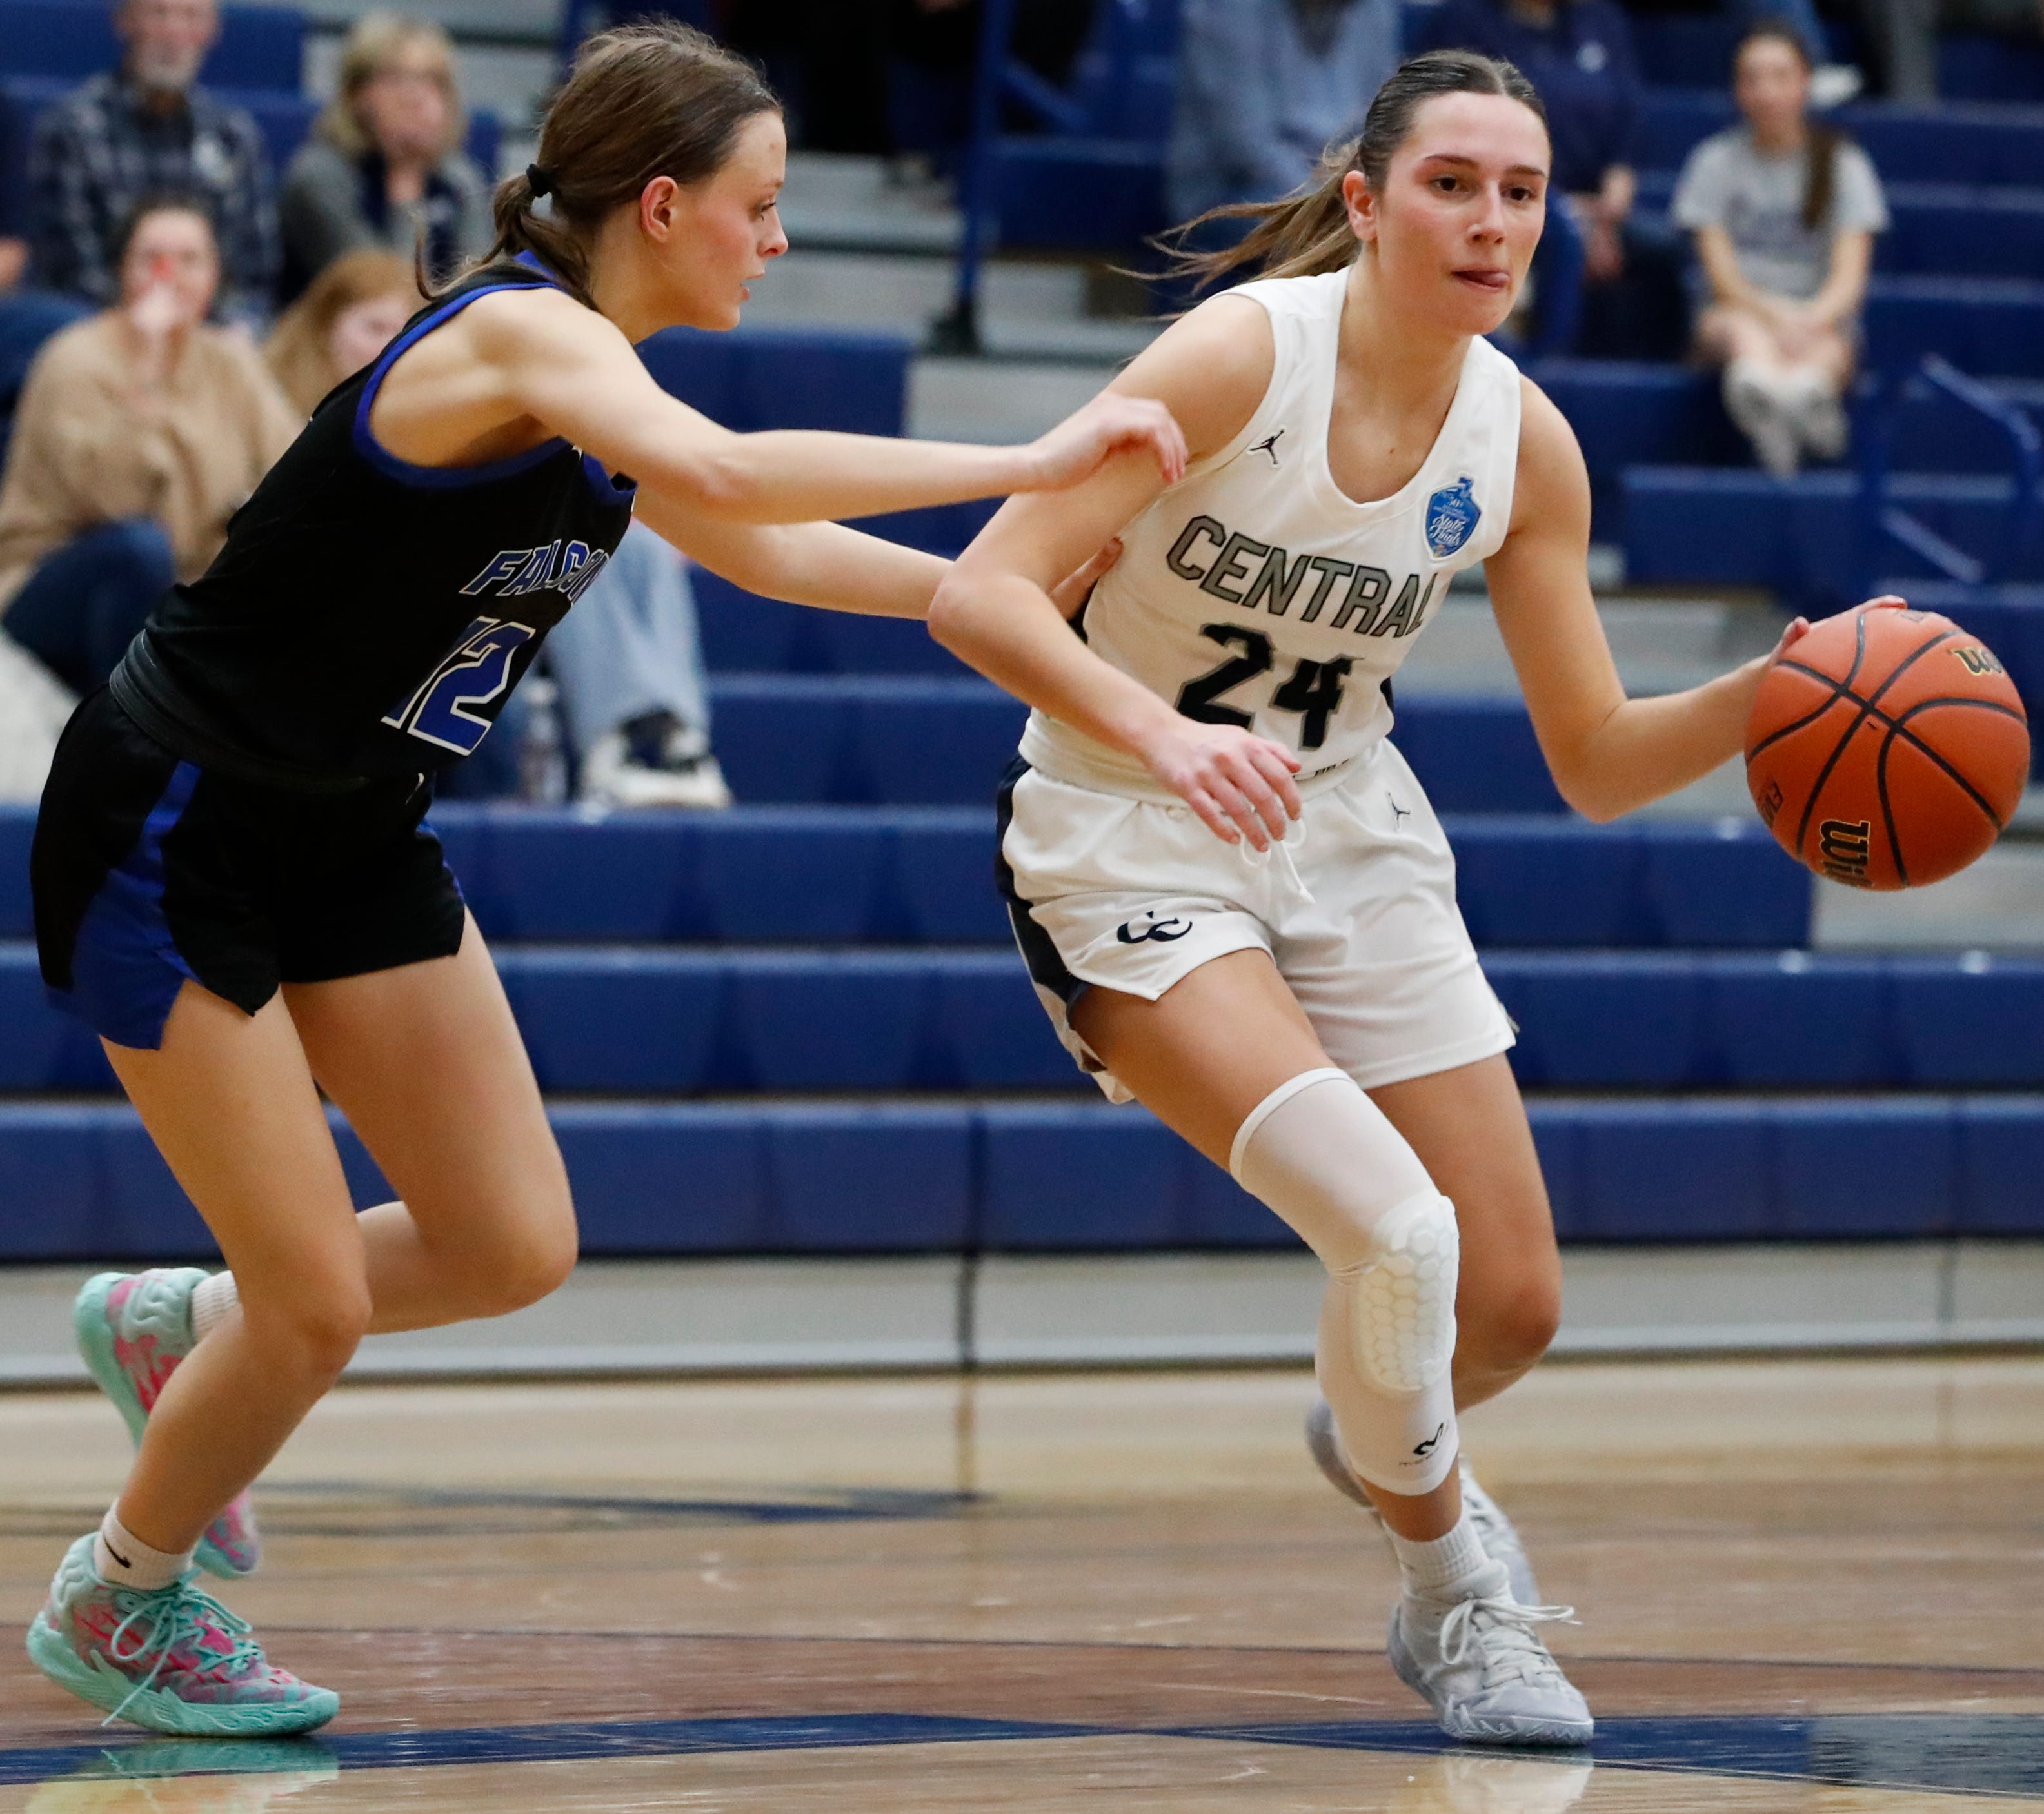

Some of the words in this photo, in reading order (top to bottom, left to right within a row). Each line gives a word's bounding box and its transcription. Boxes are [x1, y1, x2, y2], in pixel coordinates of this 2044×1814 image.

[1166, 514, 1438, 638] CENTRAL
[380, 615, 537, 756] 12
[1173, 622, 1360, 752] 24
